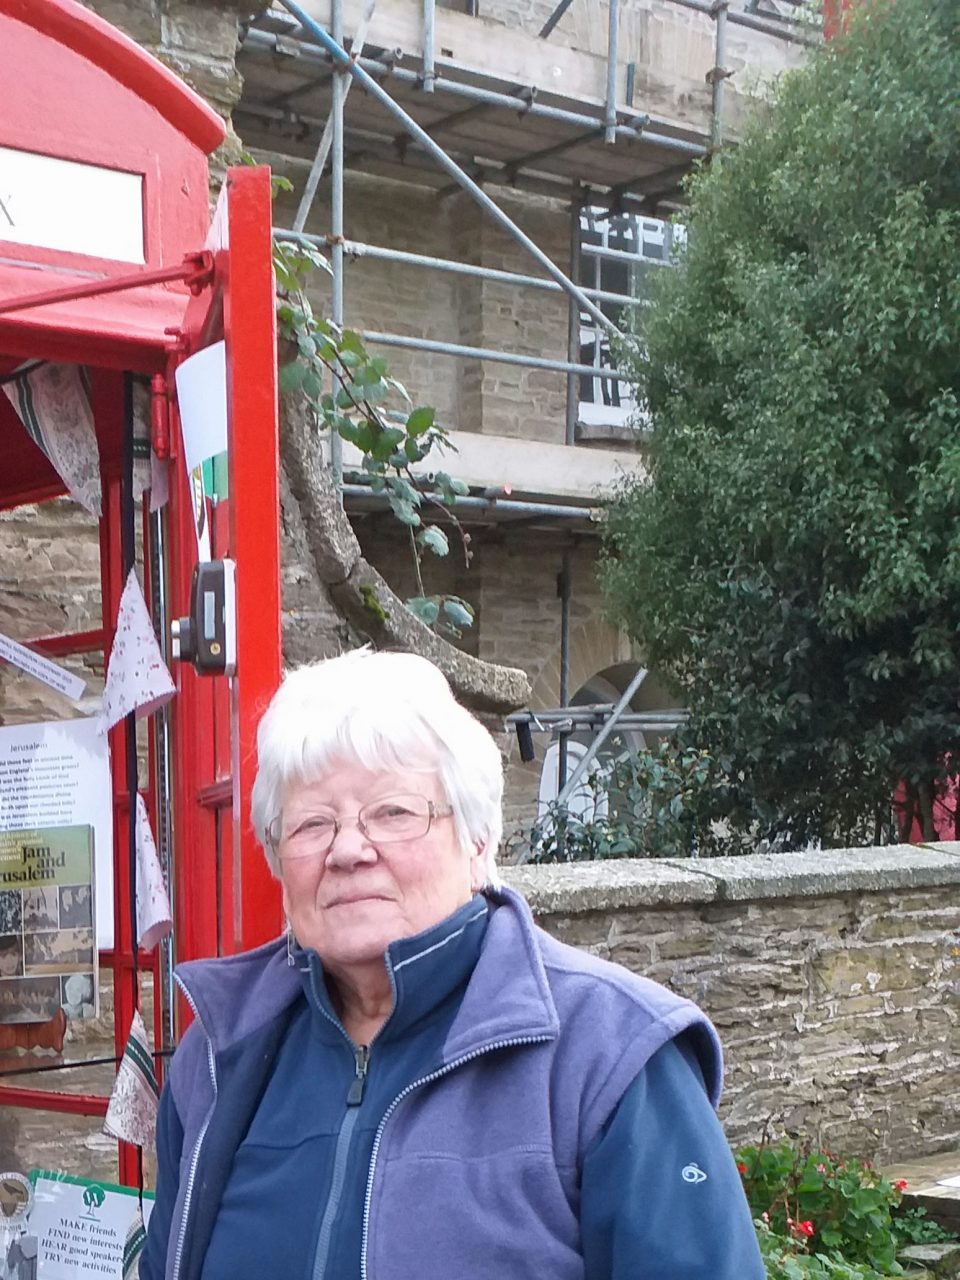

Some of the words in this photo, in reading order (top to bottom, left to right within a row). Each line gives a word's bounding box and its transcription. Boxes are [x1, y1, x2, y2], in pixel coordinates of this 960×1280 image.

[21, 847, 50, 864] Jam
[37, 851, 65, 868] and
[60, 1218, 86, 1229] MAKE
[89, 1222, 117, 1237] friends
[41, 1239, 67, 1251] HEAR
[69, 1246, 88, 1256] good
[48, 1228, 70, 1239] FIND
[72, 1234, 87, 1242] new
[90, 1237, 122, 1250] interests
[44, 1252, 62, 1262] TRY
[64, 1257, 79, 1266] new
[82, 1261, 117, 1274] activities
